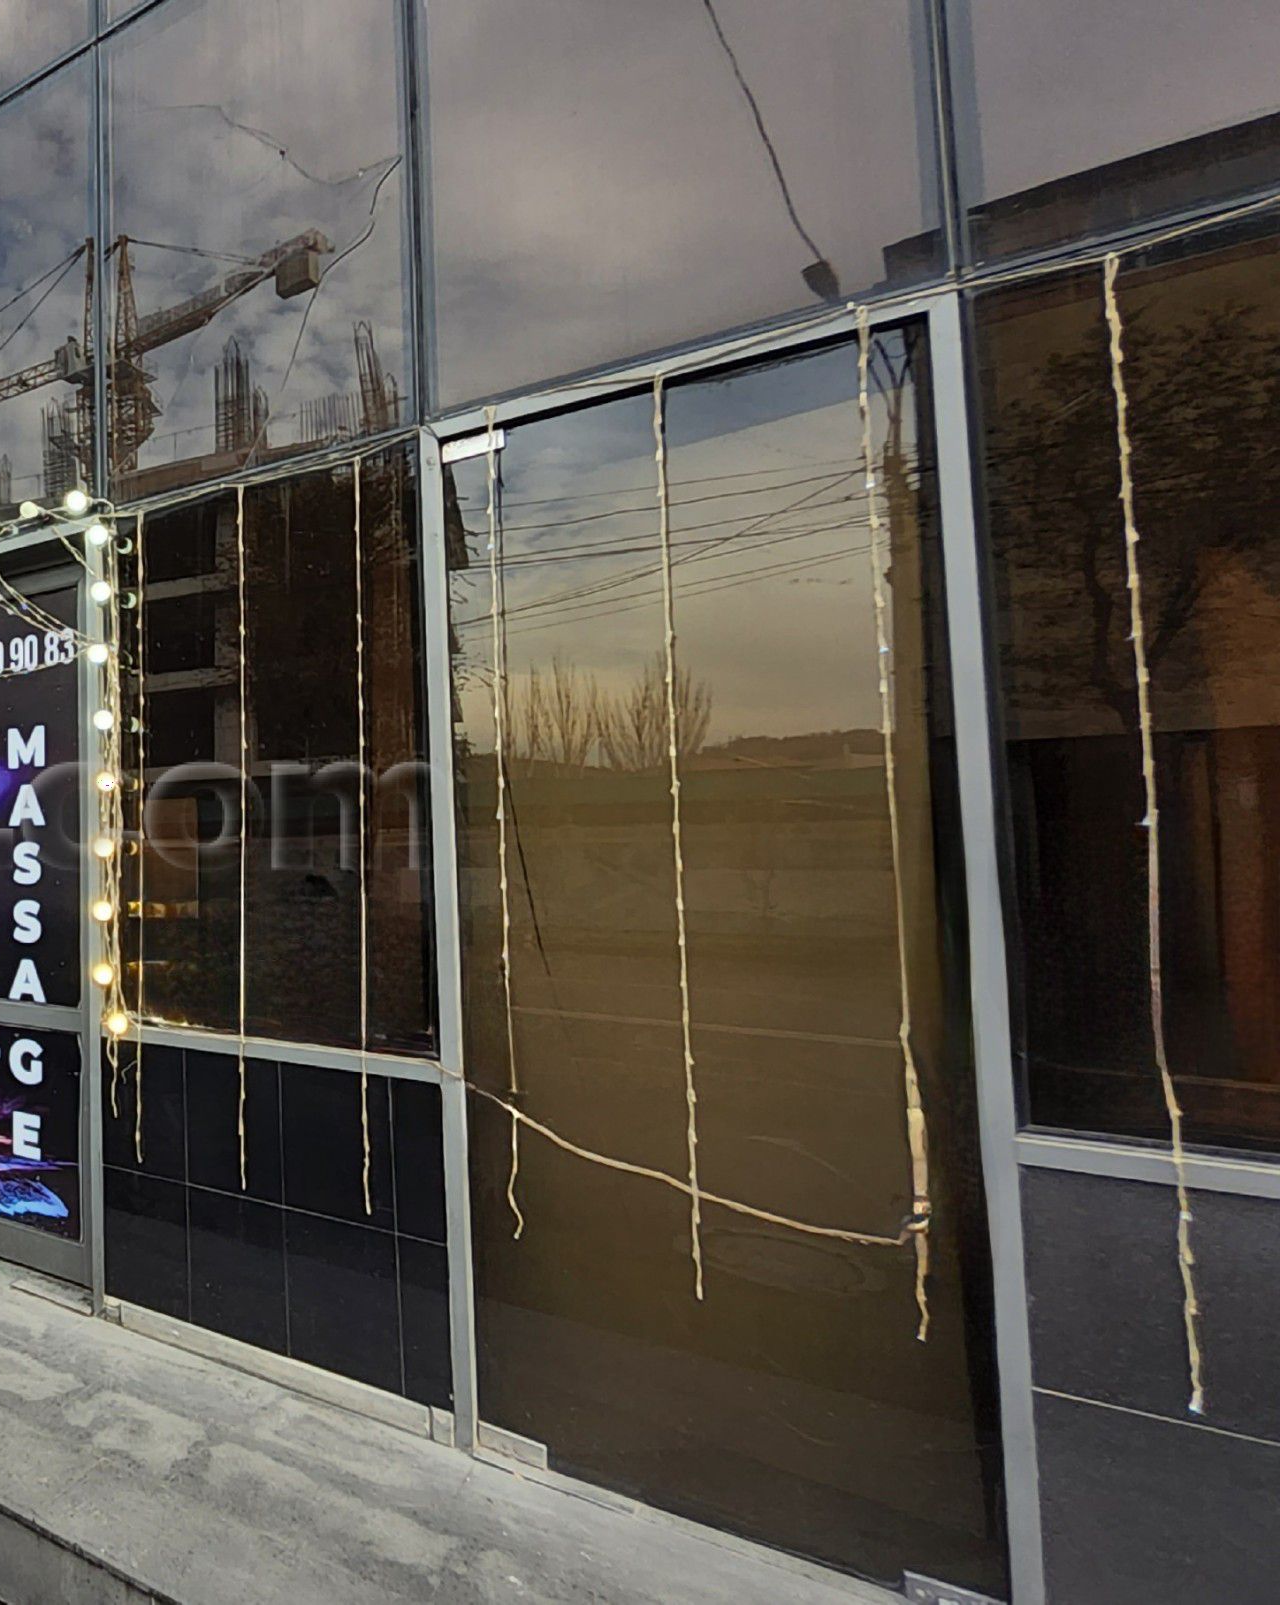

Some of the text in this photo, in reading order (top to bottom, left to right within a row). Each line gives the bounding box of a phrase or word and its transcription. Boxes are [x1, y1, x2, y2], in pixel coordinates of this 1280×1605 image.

[10, 634, 38, 672] 90
[44, 627, 75, 666] 83
[7, 724, 47, 1162] MASSAGE
